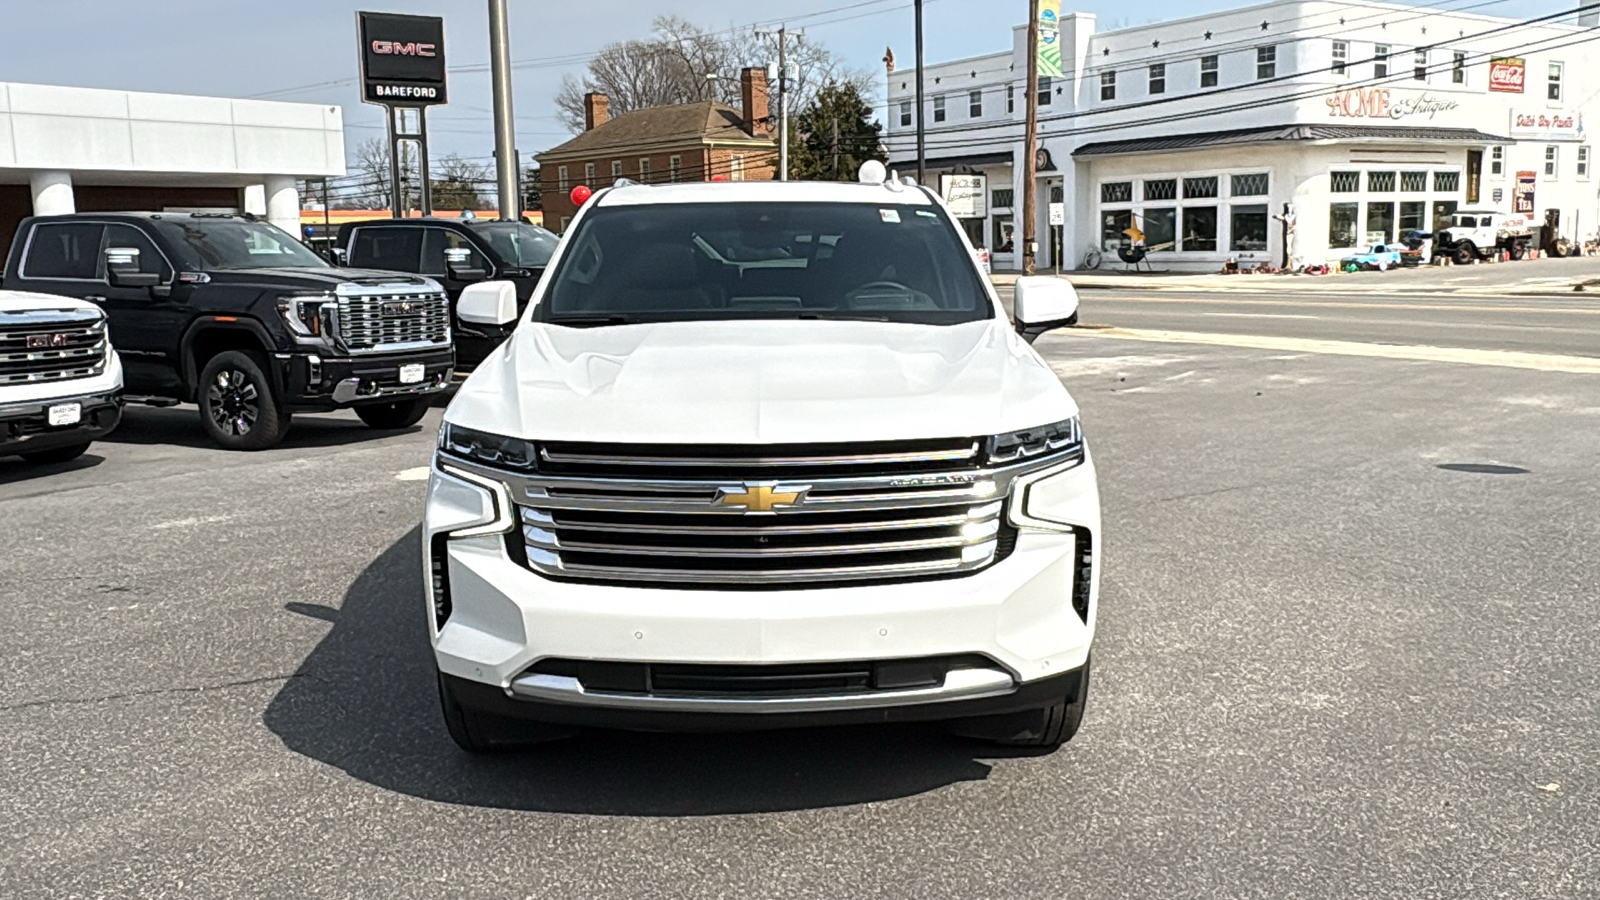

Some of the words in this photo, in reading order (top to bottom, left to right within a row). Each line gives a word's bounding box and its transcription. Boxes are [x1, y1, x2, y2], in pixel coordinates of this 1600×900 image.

[372, 40, 436, 57] GMC
[376, 85, 437, 98] BAREFORD
[1325, 87, 1391, 118] ACME
[1538, 115, 1551, 130] Boy
[1051, 213, 1062, 222] 25
